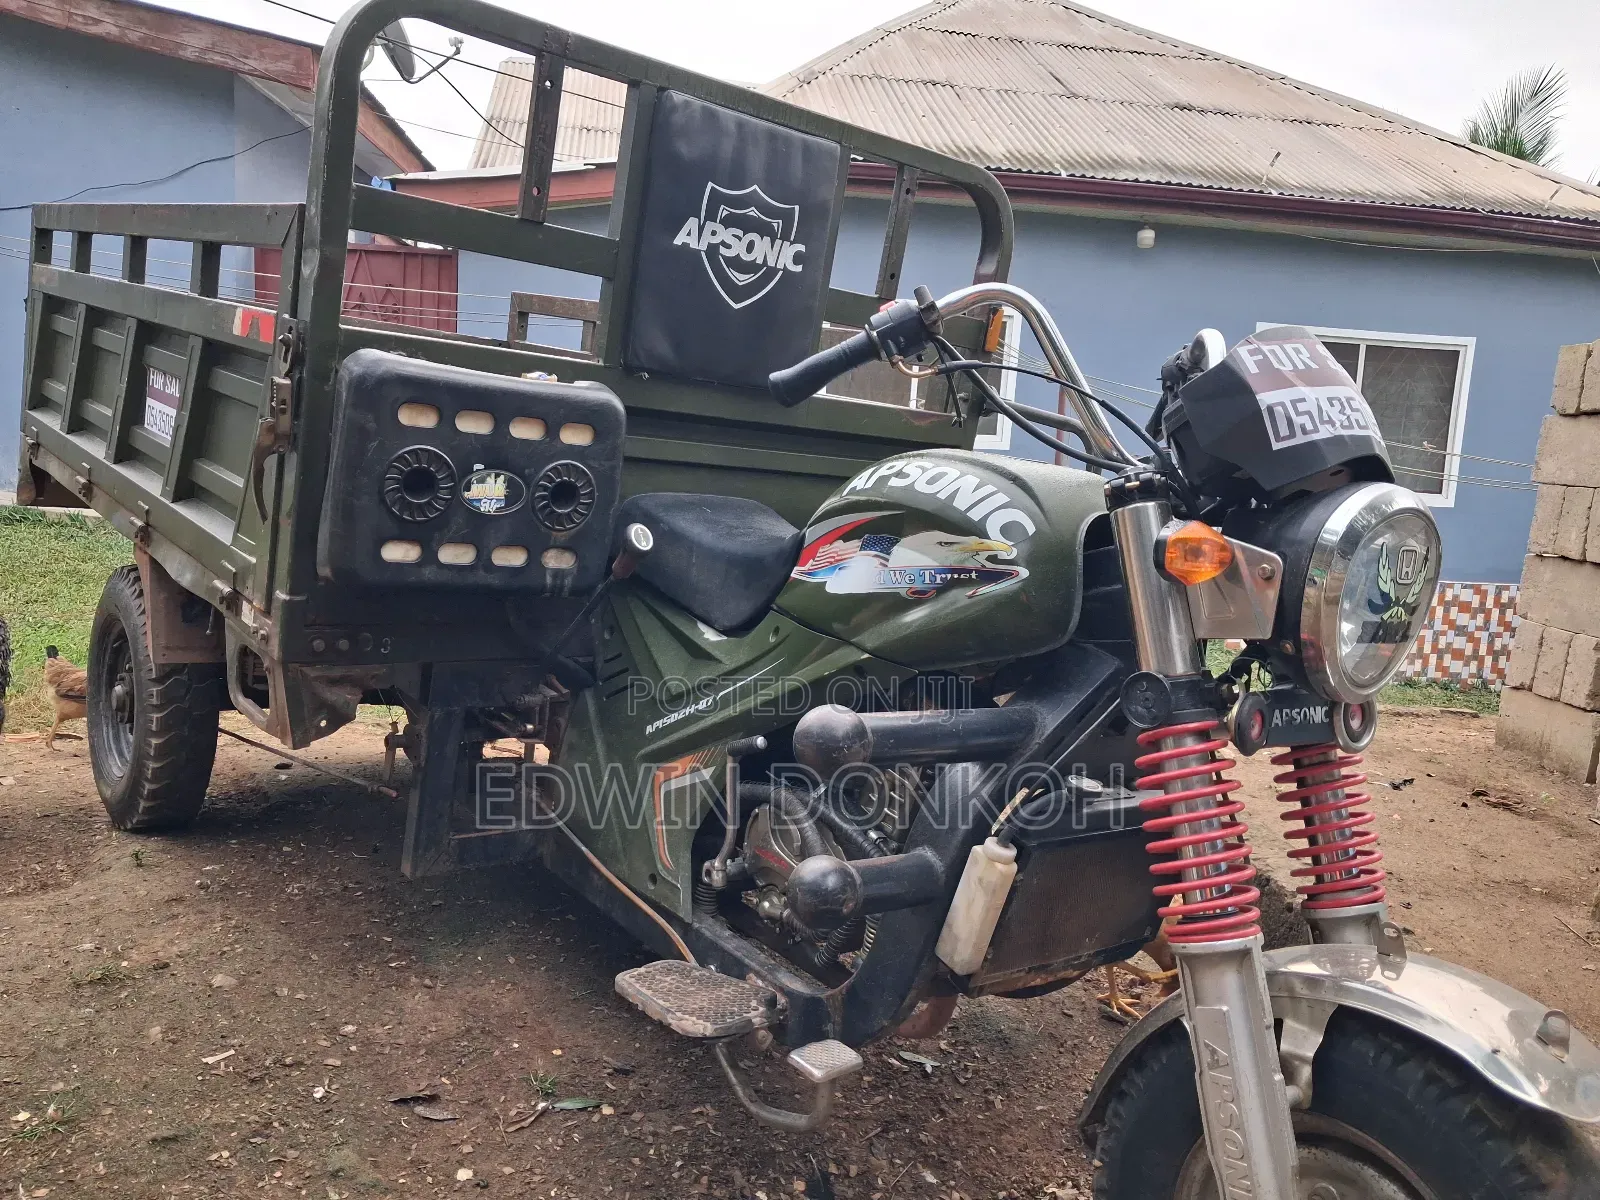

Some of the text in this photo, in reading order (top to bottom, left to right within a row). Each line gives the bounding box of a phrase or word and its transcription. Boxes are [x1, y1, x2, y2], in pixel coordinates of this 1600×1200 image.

[673, 217, 805, 272] APSONIC
[1236, 343, 1319, 373] FOR
[149, 367, 165, 391] FOR
[842, 460, 1036, 545] APSONIC
[889, 570, 915, 584] We
[1271, 705, 1330, 728] APSONIC
